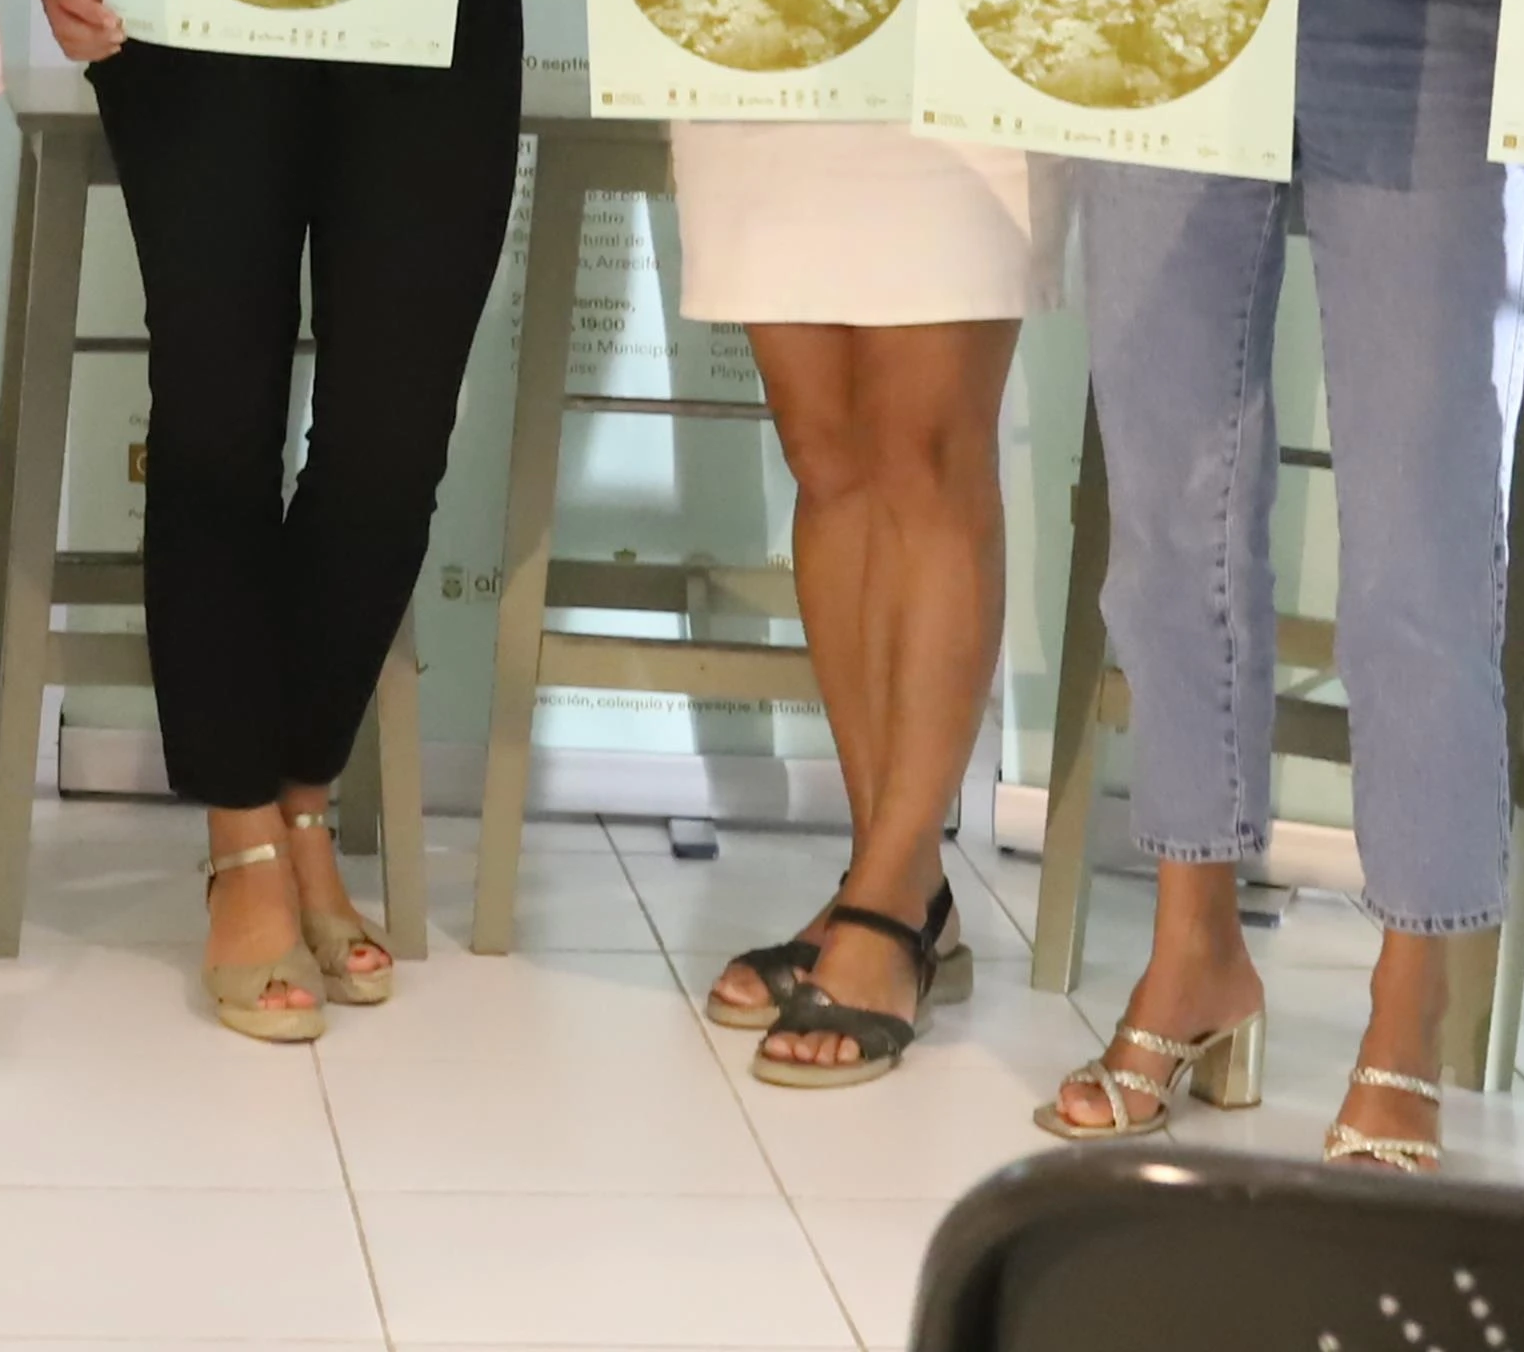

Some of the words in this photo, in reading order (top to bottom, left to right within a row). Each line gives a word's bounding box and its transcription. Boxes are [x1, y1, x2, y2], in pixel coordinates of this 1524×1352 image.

[579, 317, 626, 332] 19:00
[596, 340, 680, 358] Municipal
[596, 695, 662, 715] coloquio
[664, 700, 675, 715] y
